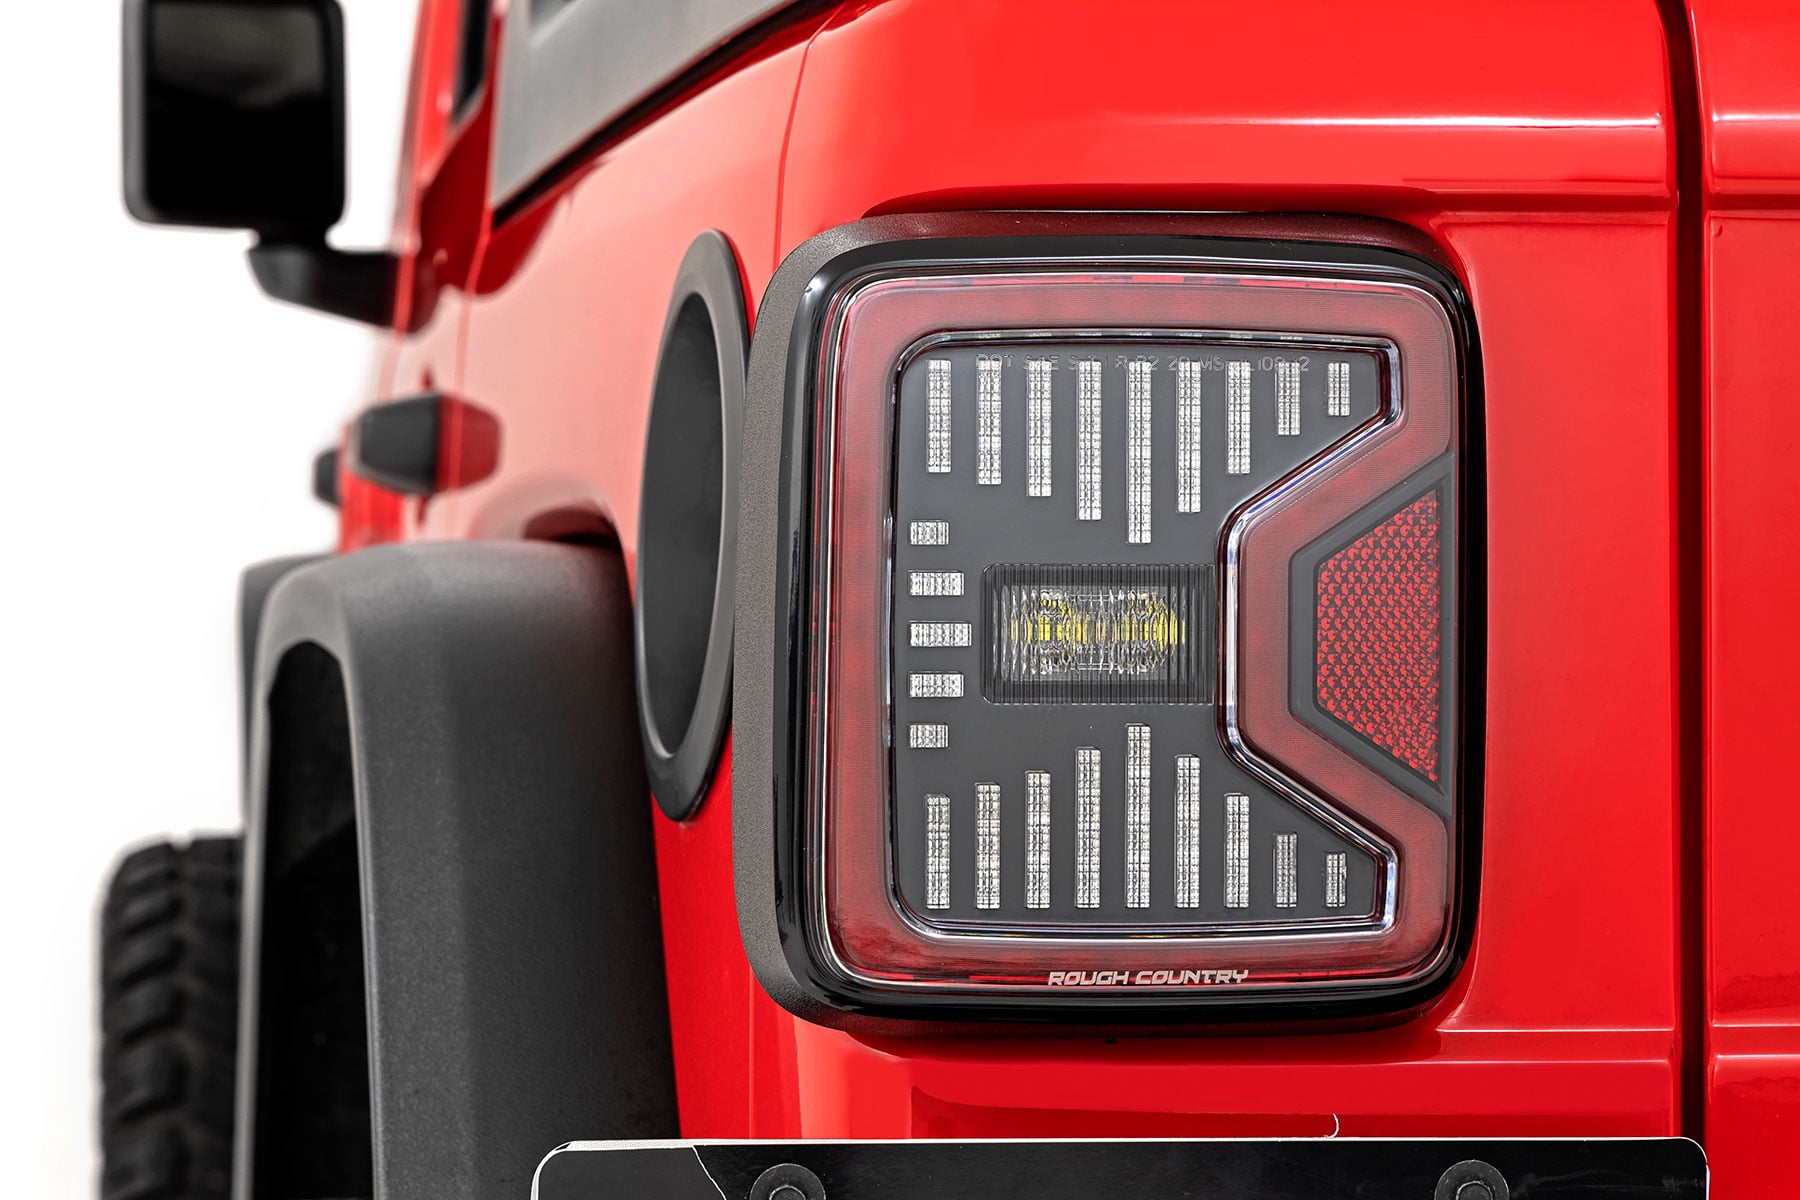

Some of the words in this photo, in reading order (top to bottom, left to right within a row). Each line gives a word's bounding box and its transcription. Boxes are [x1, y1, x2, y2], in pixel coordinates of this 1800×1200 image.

[976, 354, 1014, 369] DOT
[1114, 355, 1128, 370] R
[1048, 971, 1129, 986] ROUGH
[1135, 970, 1249, 985] COUNTRY
